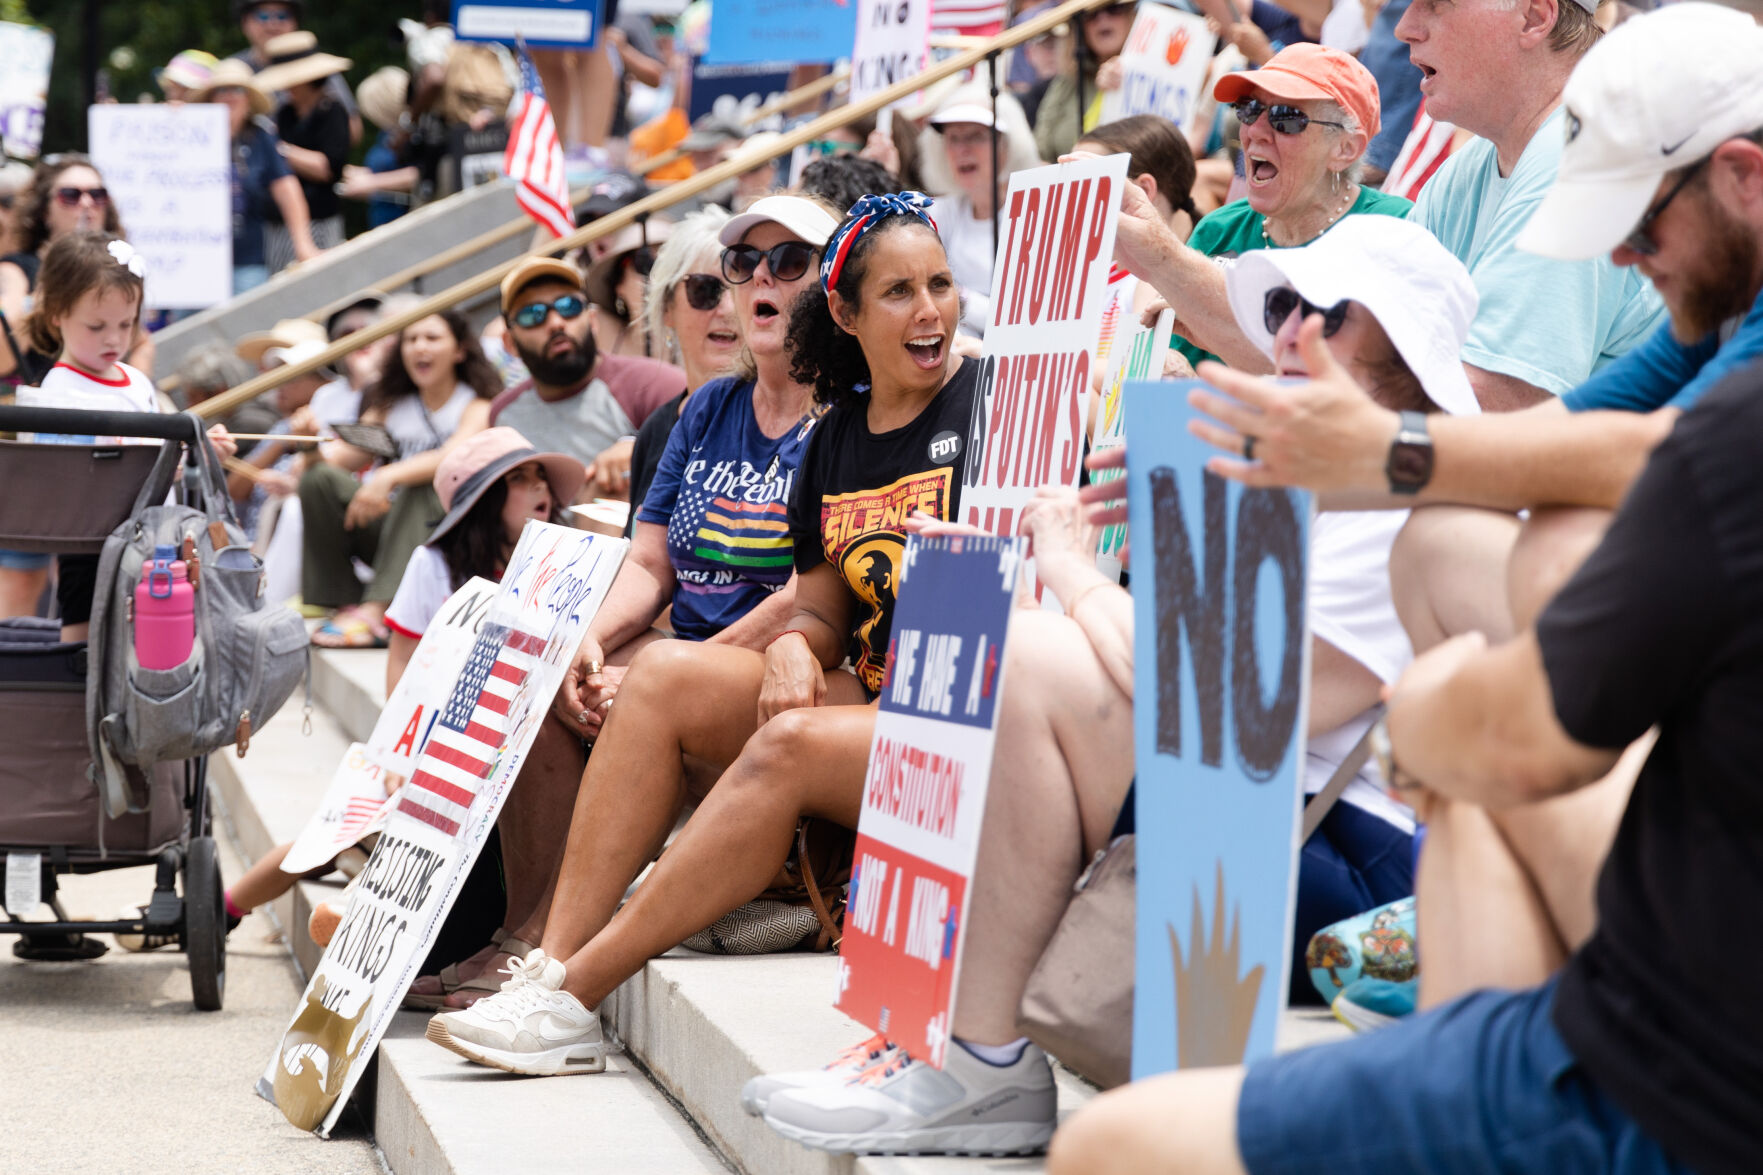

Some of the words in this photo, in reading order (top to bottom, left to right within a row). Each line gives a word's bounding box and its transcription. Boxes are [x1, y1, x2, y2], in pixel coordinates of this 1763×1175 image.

[872, 1, 909, 28] NO
[994, 176, 1111, 326] TRUMP
[931, 436, 958, 459] FDT
[963, 354, 994, 488] IS
[982, 349, 1089, 488] PUTIN'S
[703, 460, 743, 499] the
[739, 461, 795, 512] Peopl
[825, 490, 938, 557] SILENCE
[854, 499, 883, 511] COMES
[885, 496, 891, 505] A
[909, 480, 938, 494] WHEN
[713, 571, 733, 584] IN
[1149, 465, 1303, 782] NO
[892, 629, 921, 706] WE
[917, 634, 962, 716] HAVE
[965, 634, 987, 716] A
[869, 735, 965, 839] CONSTITUTION
[359, 834, 445, 912] RESISTING
[853, 852, 887, 937] NOT
[883, 866, 902, 947] A
[905, 875, 949, 971] KING
[328, 897, 407, 984] KINGS
